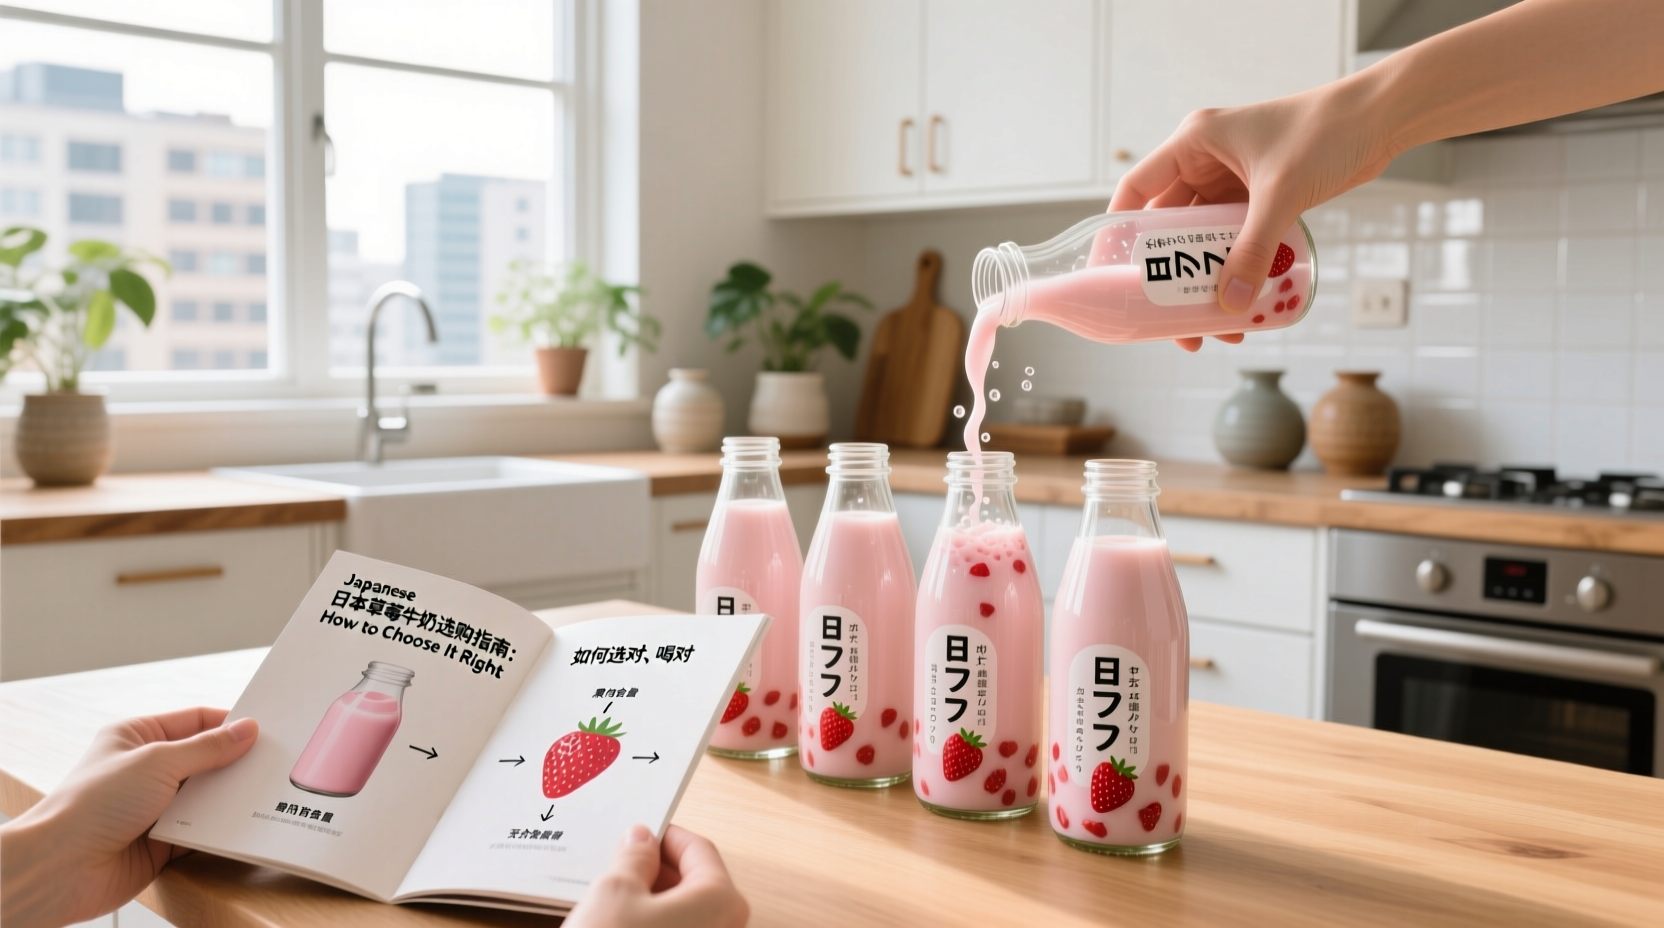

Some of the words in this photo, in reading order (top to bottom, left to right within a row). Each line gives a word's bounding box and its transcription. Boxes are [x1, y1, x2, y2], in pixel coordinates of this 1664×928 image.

[343, 573, 417, 601] Japanese
[319, 610, 359, 631] How
[361, 621, 378, 635] to
[382, 625, 441, 653] Choose
[443, 643, 459, 659] It
[459, 648, 504, 679] Right
